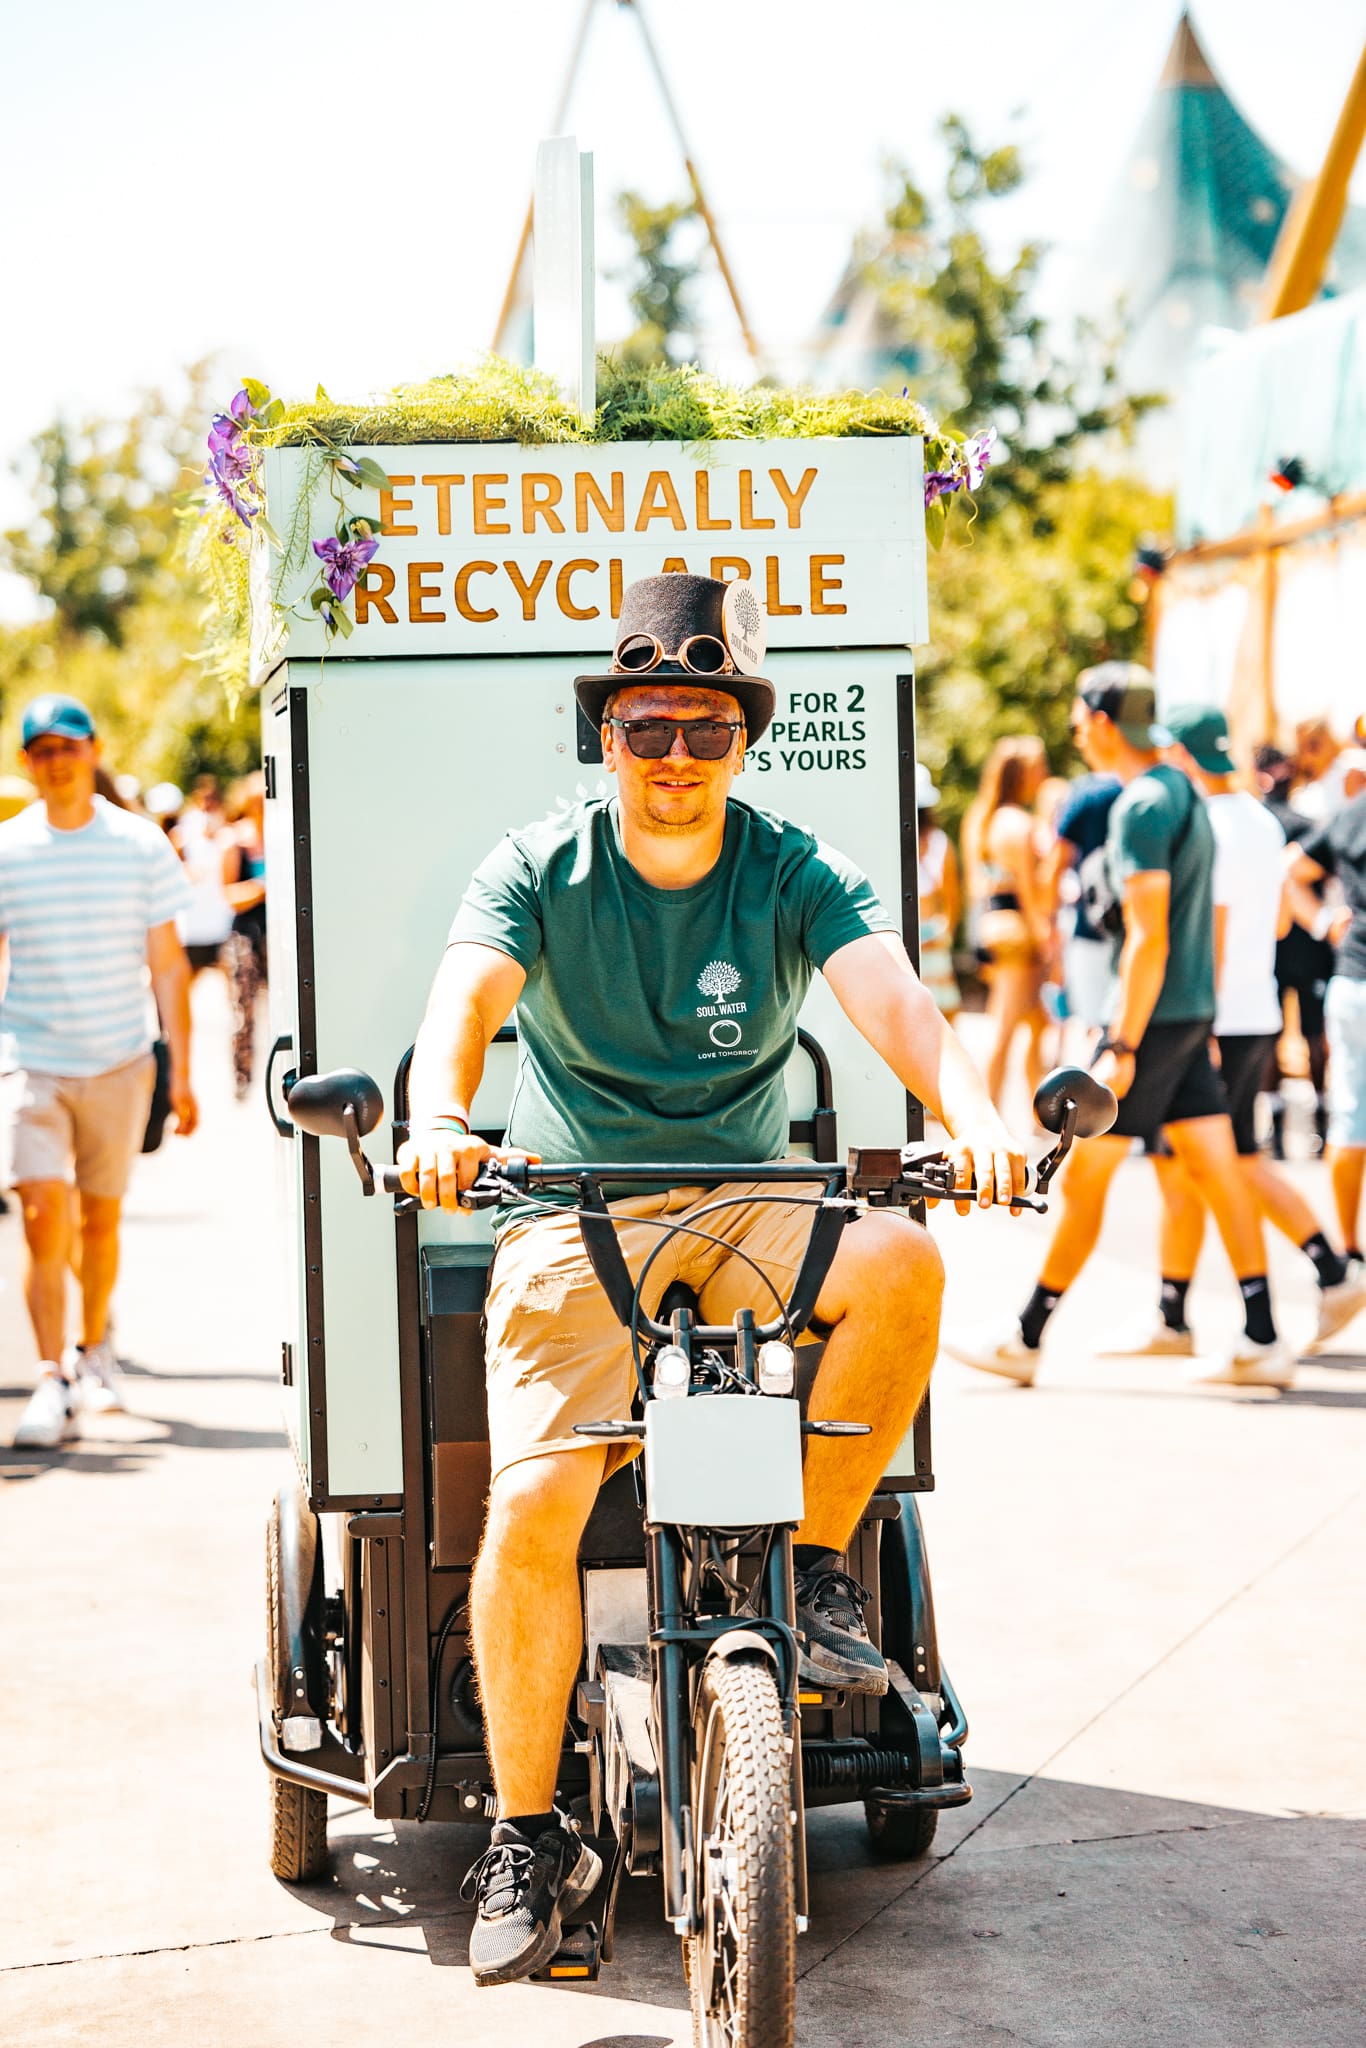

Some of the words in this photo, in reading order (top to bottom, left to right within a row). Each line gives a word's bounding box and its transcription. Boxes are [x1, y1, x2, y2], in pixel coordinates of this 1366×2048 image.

[379, 468, 818, 537] ETERNALLY
[354, 553, 848, 625] RECYCLLE
[731, 633, 742, 655] SOUL
[742, 647, 758, 665] WATER
[789, 692, 839, 714] FOR
[846, 684, 866, 713] 2
[771, 720, 867, 743] PEARLS
[779, 749, 867, 772] YOURS
[696, 1006, 718, 1018] SOUL
[719, 1002, 747, 1015] WATER
[718, 1048, 759, 1057] TOMORROW
